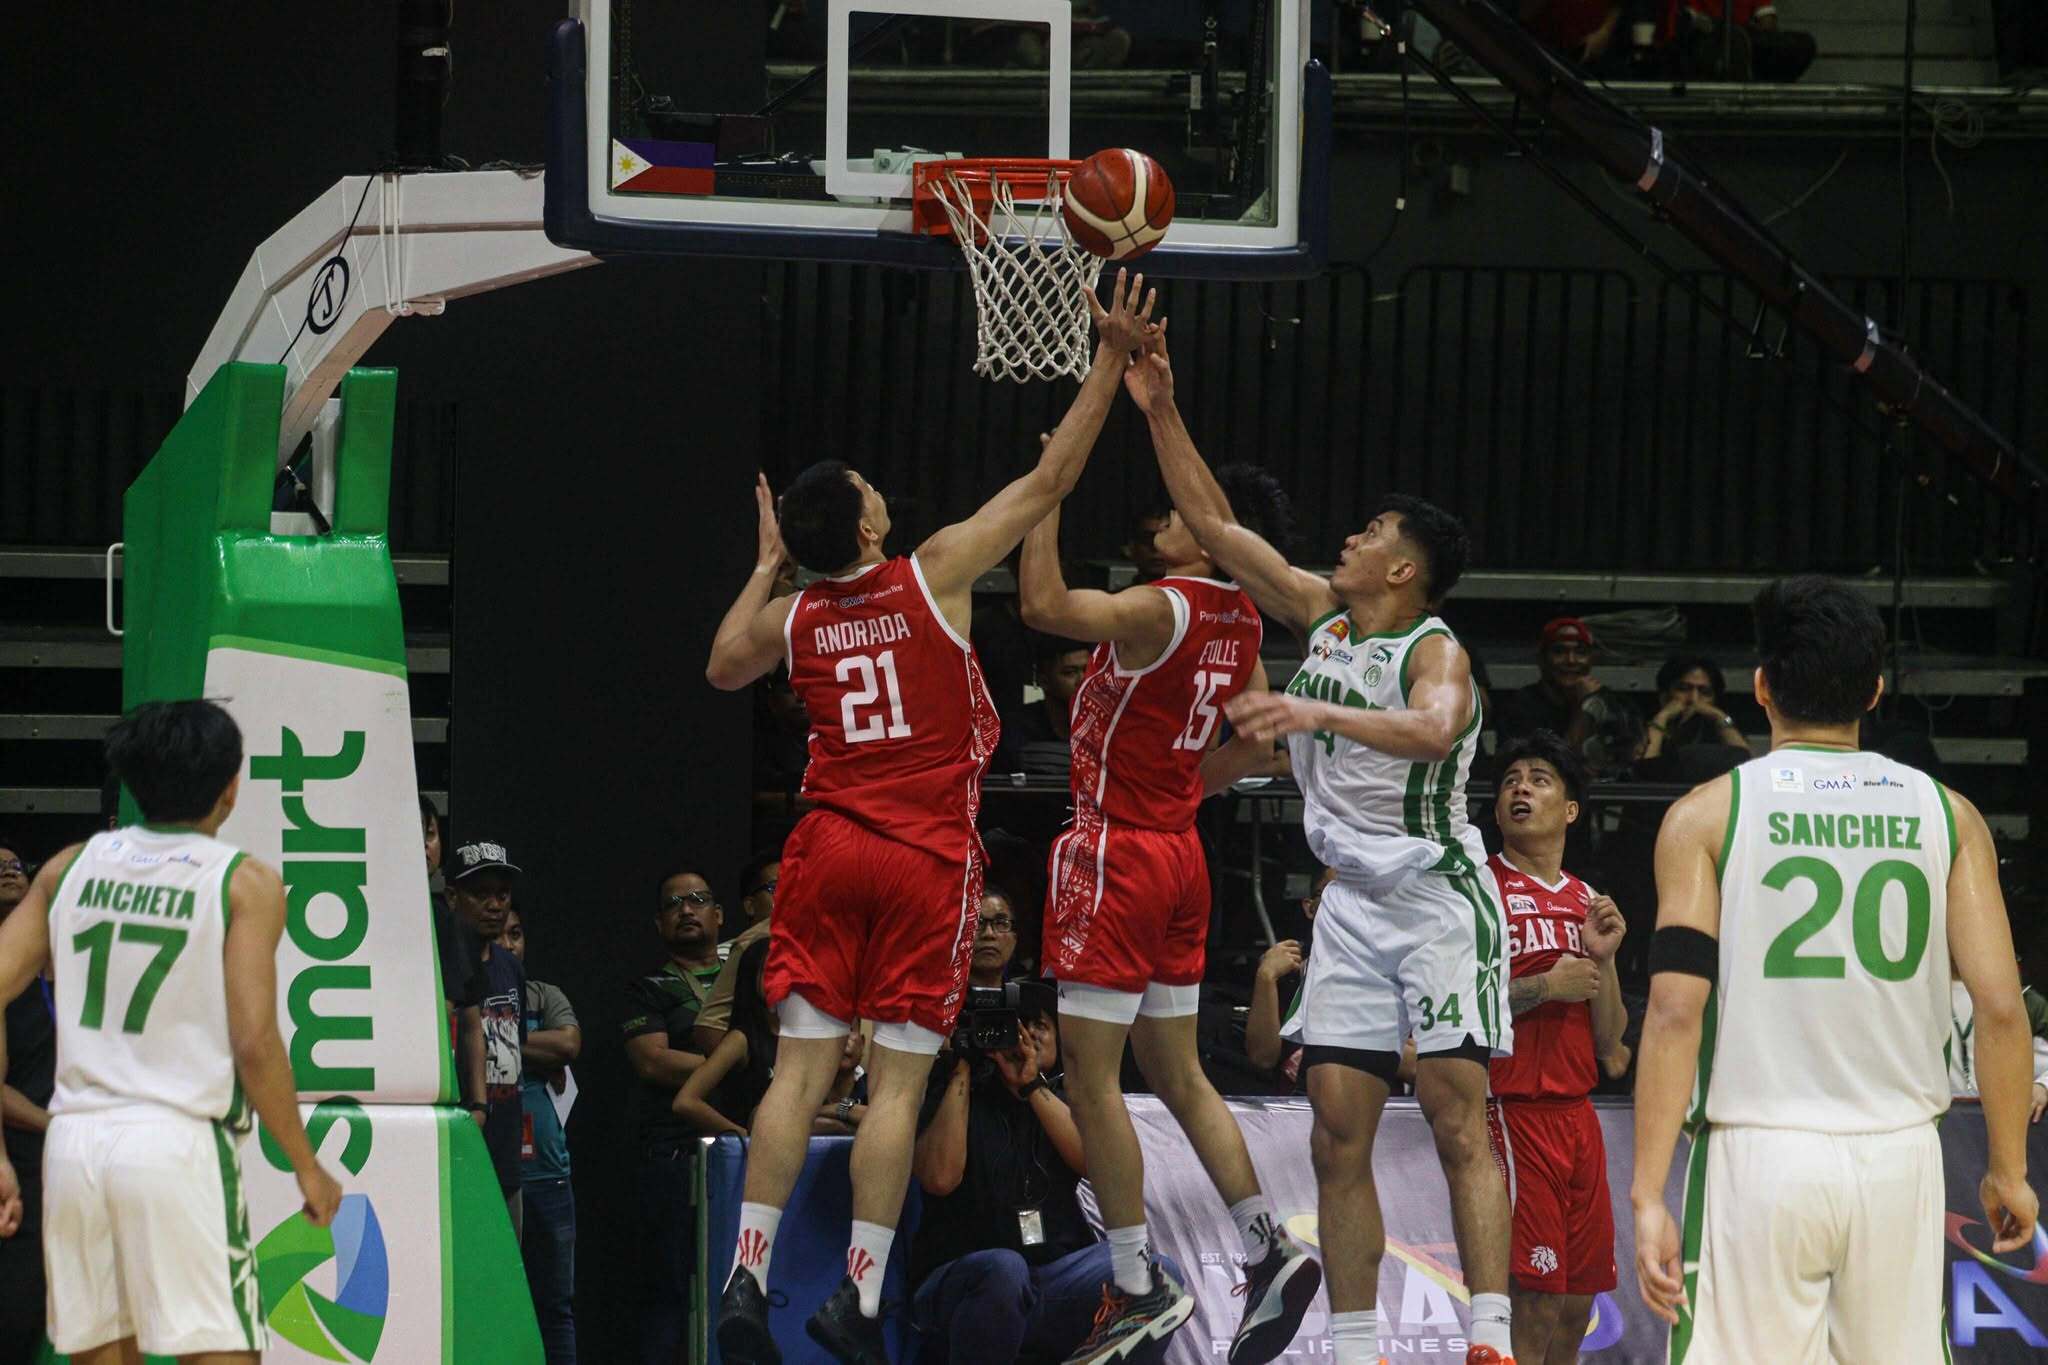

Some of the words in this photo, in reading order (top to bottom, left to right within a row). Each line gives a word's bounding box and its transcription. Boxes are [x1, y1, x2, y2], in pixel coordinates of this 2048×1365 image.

[814, 612, 911, 655] ANDRADA
[835, 650, 911, 743] 21
[1172, 670, 1232, 751] 15
[1813, 779, 1853, 790] GMA
[1767, 811, 1922, 850] SANCHEZ
[76, 878, 196, 919] ANCHETA
[1761, 856, 1931, 982] 20
[249, 726, 375, 1177] smart
[1509, 917, 1560, 957] SAN
[72, 920, 188, 1036] 17
[1416, 993, 1463, 1031] 34
[1200, 1252, 1225, 1263] EST.
